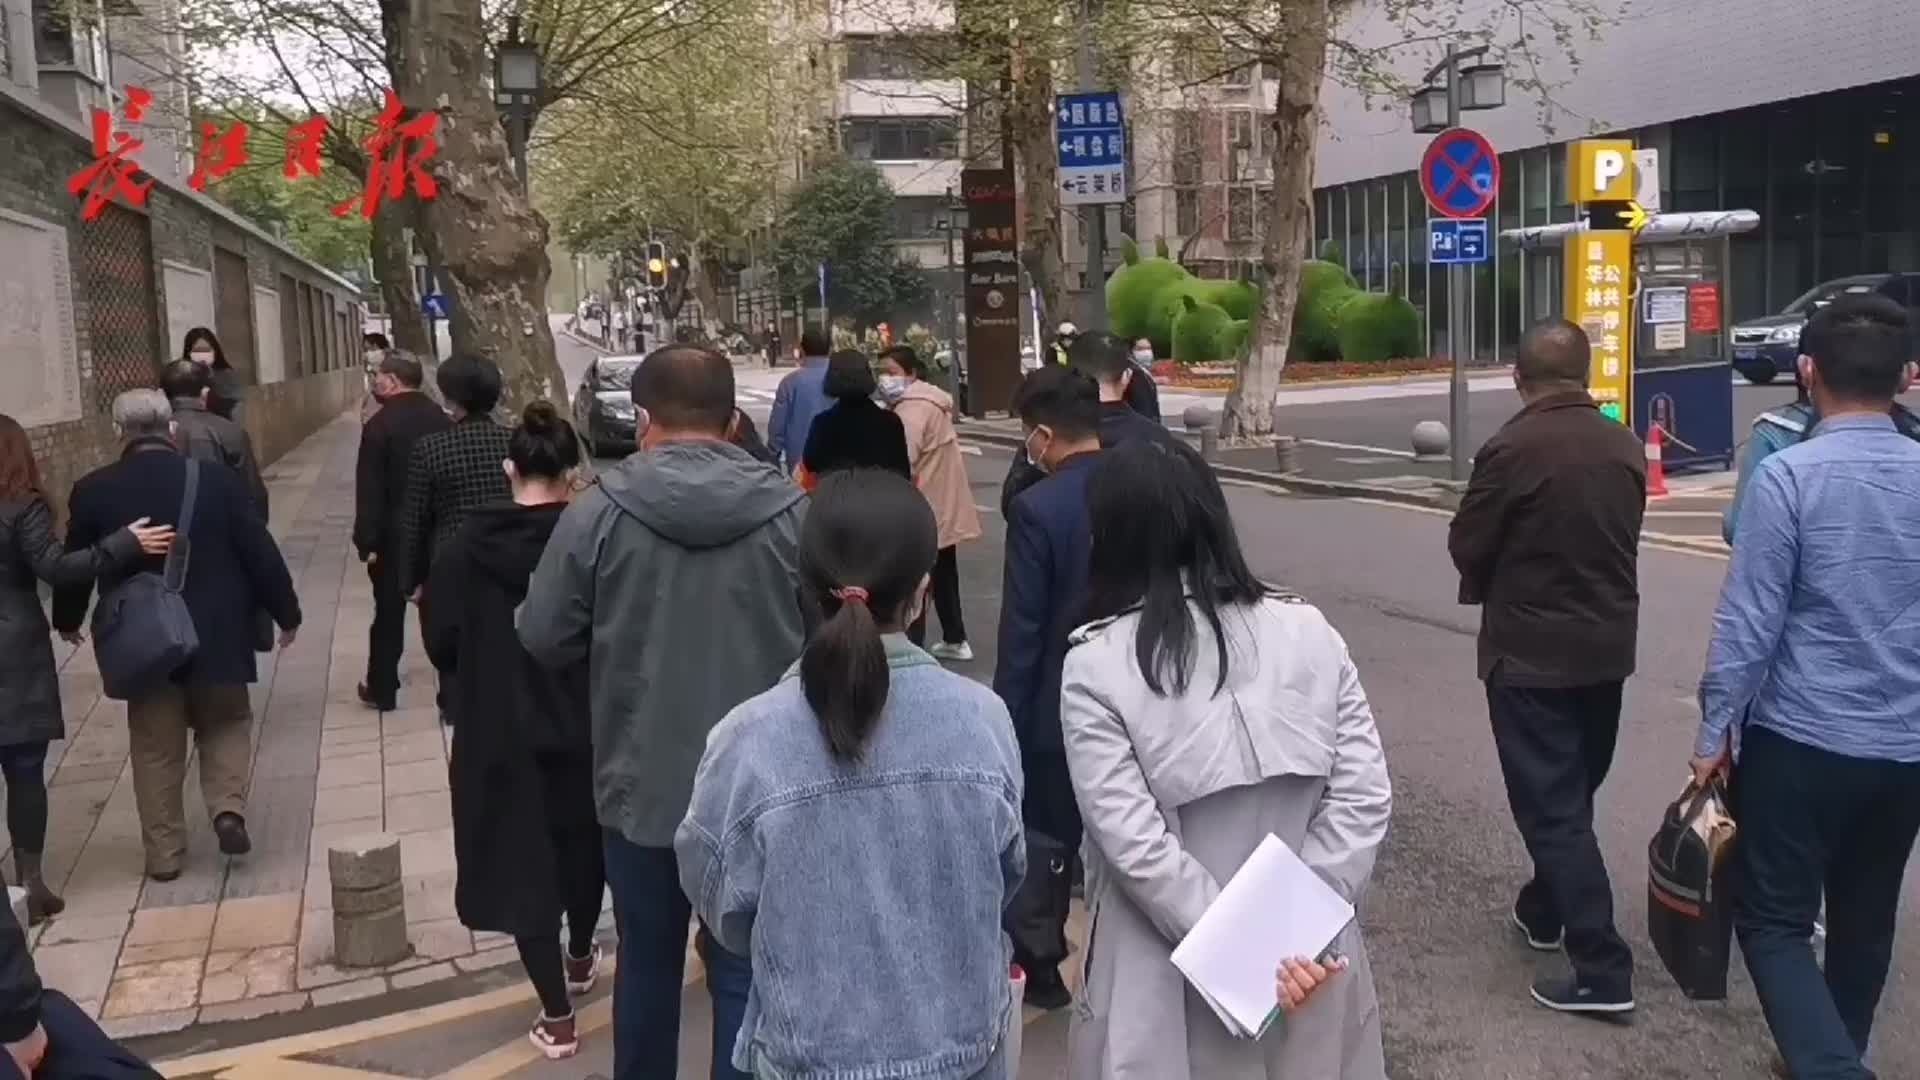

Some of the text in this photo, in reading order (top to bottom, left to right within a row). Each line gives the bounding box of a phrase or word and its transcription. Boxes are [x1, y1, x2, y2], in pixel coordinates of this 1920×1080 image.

[1594, 149, 1624, 191] P
[1603, 265, 1621, 376] 公共停车楼
